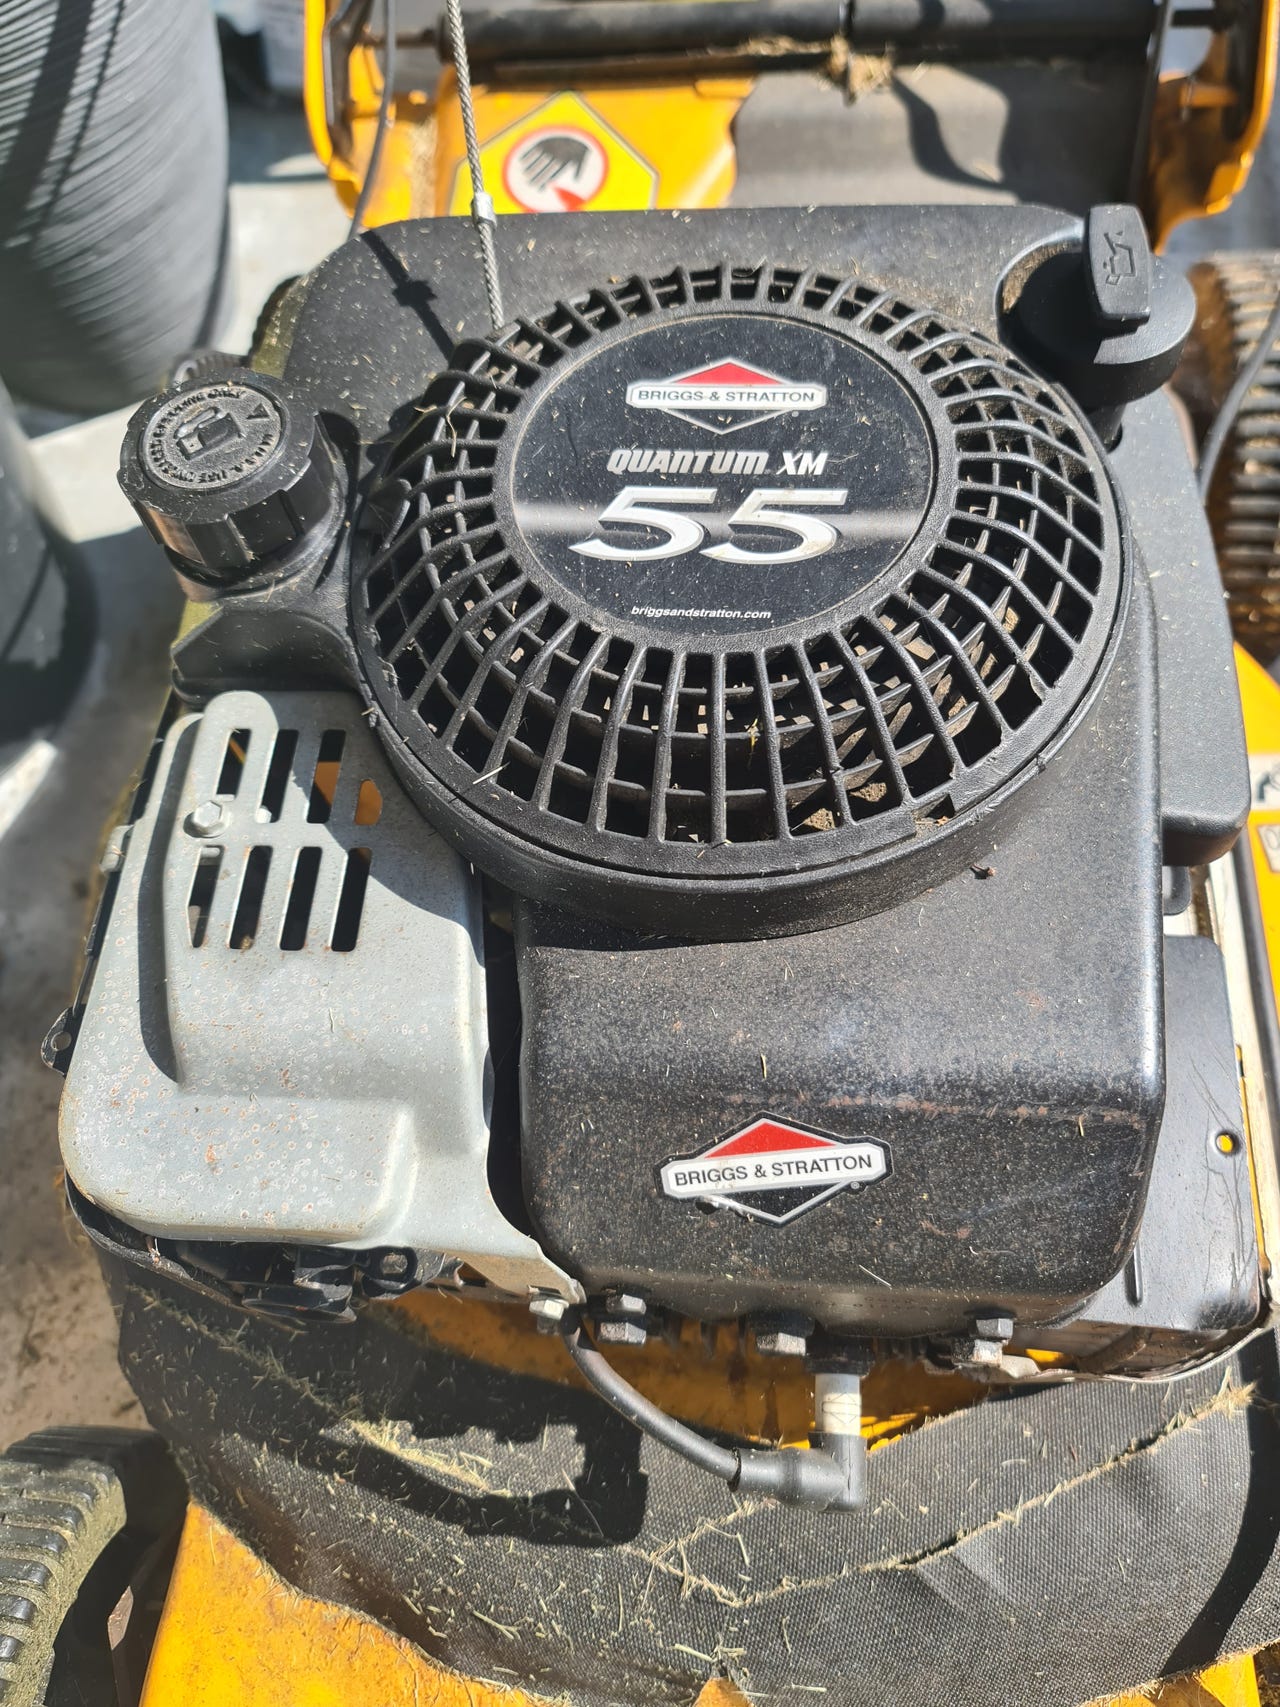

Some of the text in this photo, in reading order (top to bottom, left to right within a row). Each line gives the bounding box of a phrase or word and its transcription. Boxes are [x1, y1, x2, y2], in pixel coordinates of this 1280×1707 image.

[638, 390, 815, 403] BRIGGS & STRATTON
[607, 449, 829, 475] QUANTUM XM
[568, 486, 849, 565] 55
[631, 606, 772, 619] briggsandstratton.com
[674, 1153, 873, 1187] BRIGGS & STRATTON
